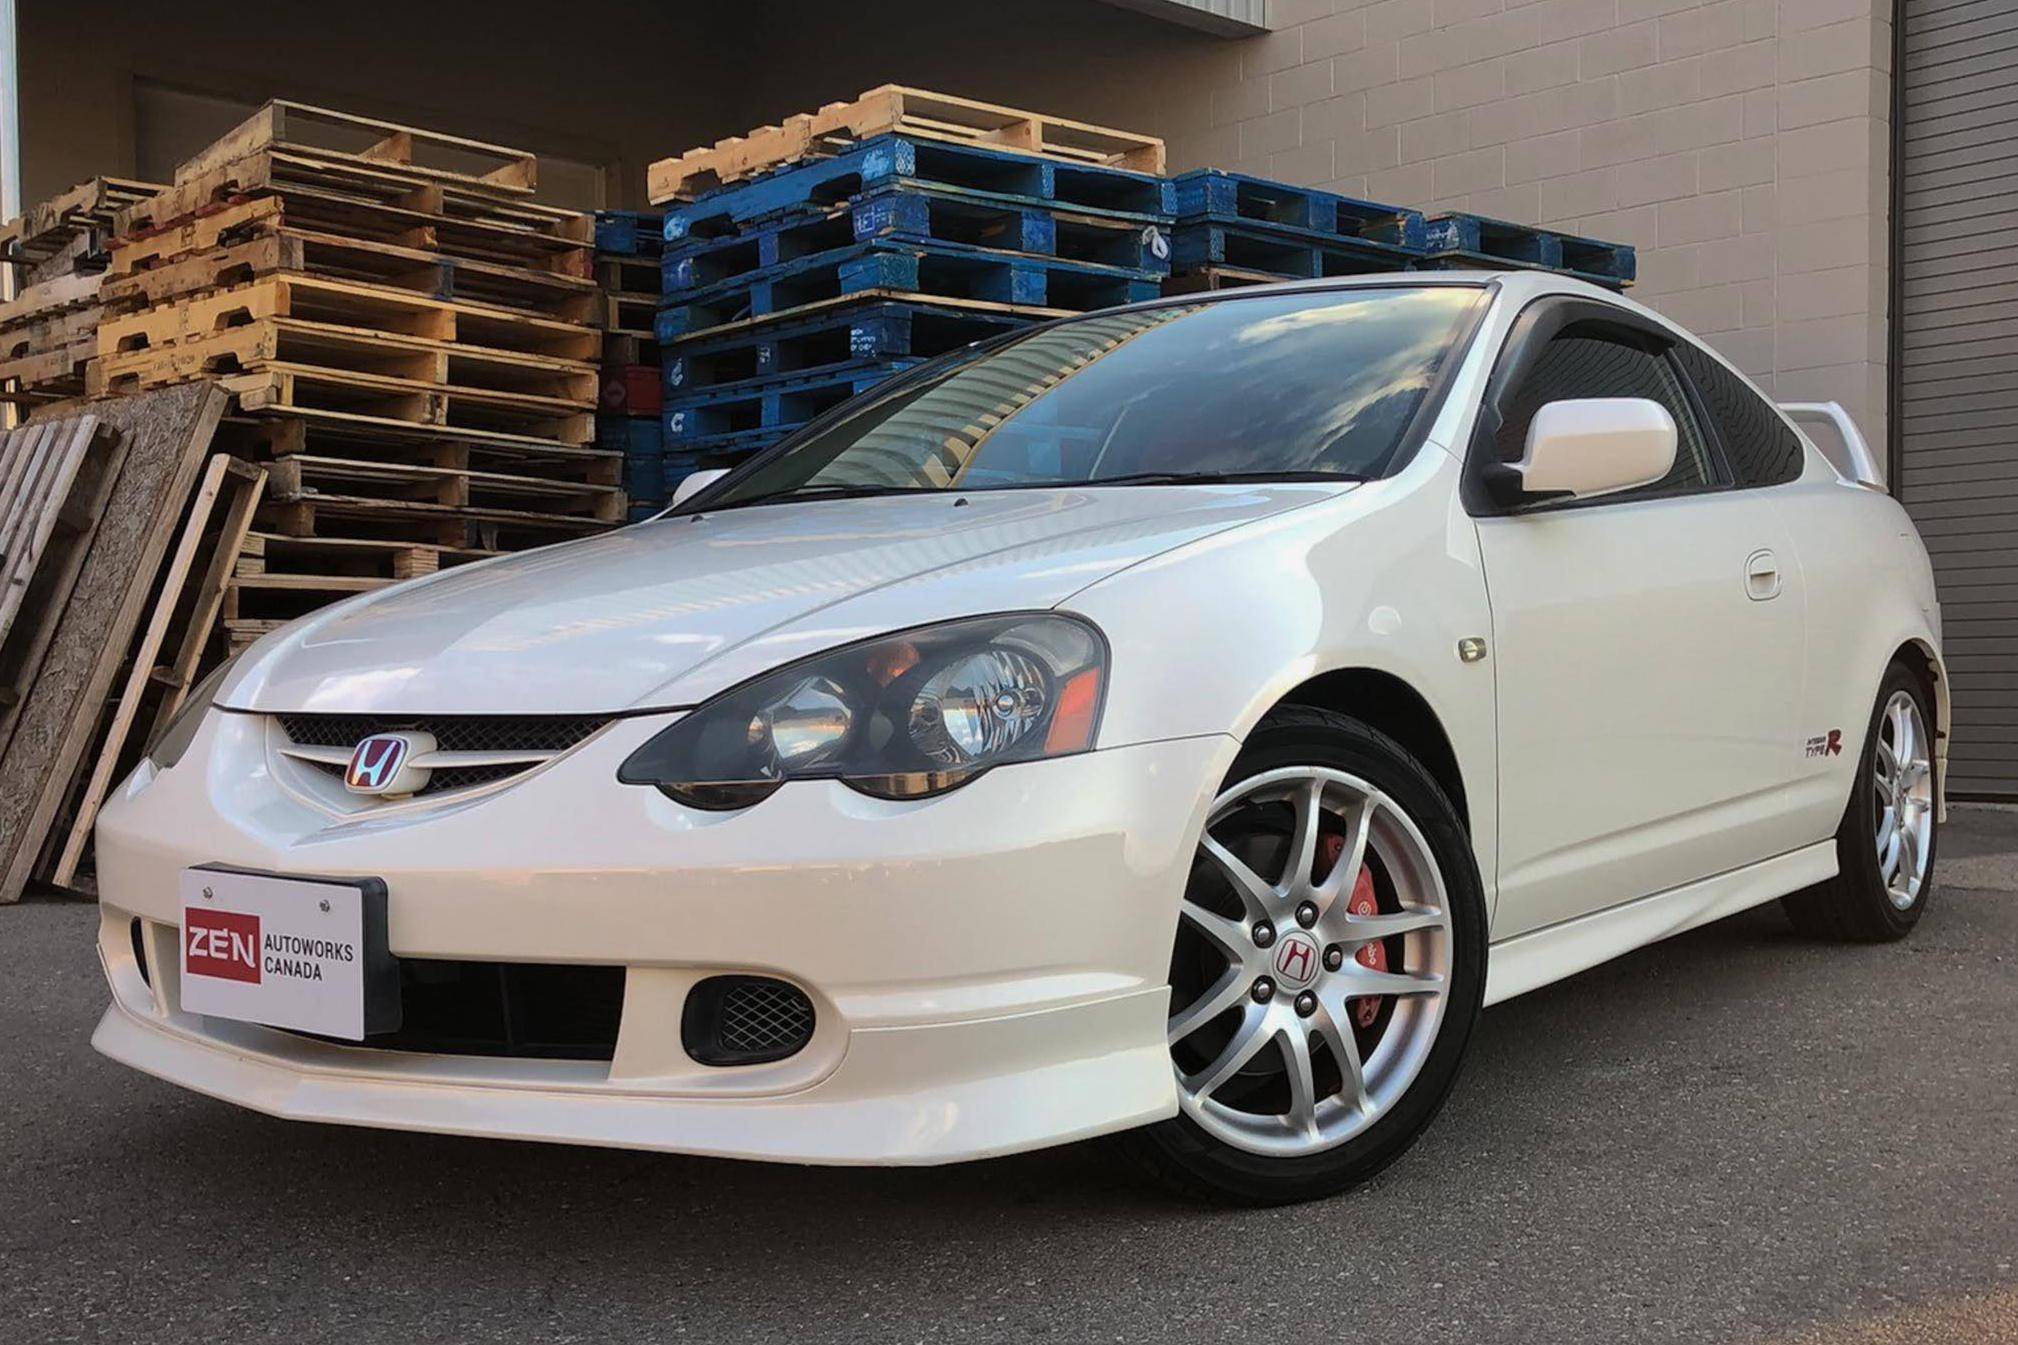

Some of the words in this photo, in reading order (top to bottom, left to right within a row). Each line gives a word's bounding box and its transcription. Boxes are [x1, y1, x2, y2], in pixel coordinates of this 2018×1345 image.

[1825, 729, 1842, 757] R
[188, 926, 256, 968] ZEN
[264, 934, 354, 962] AUTOWORKS
[264, 956, 323, 981] CANADA
